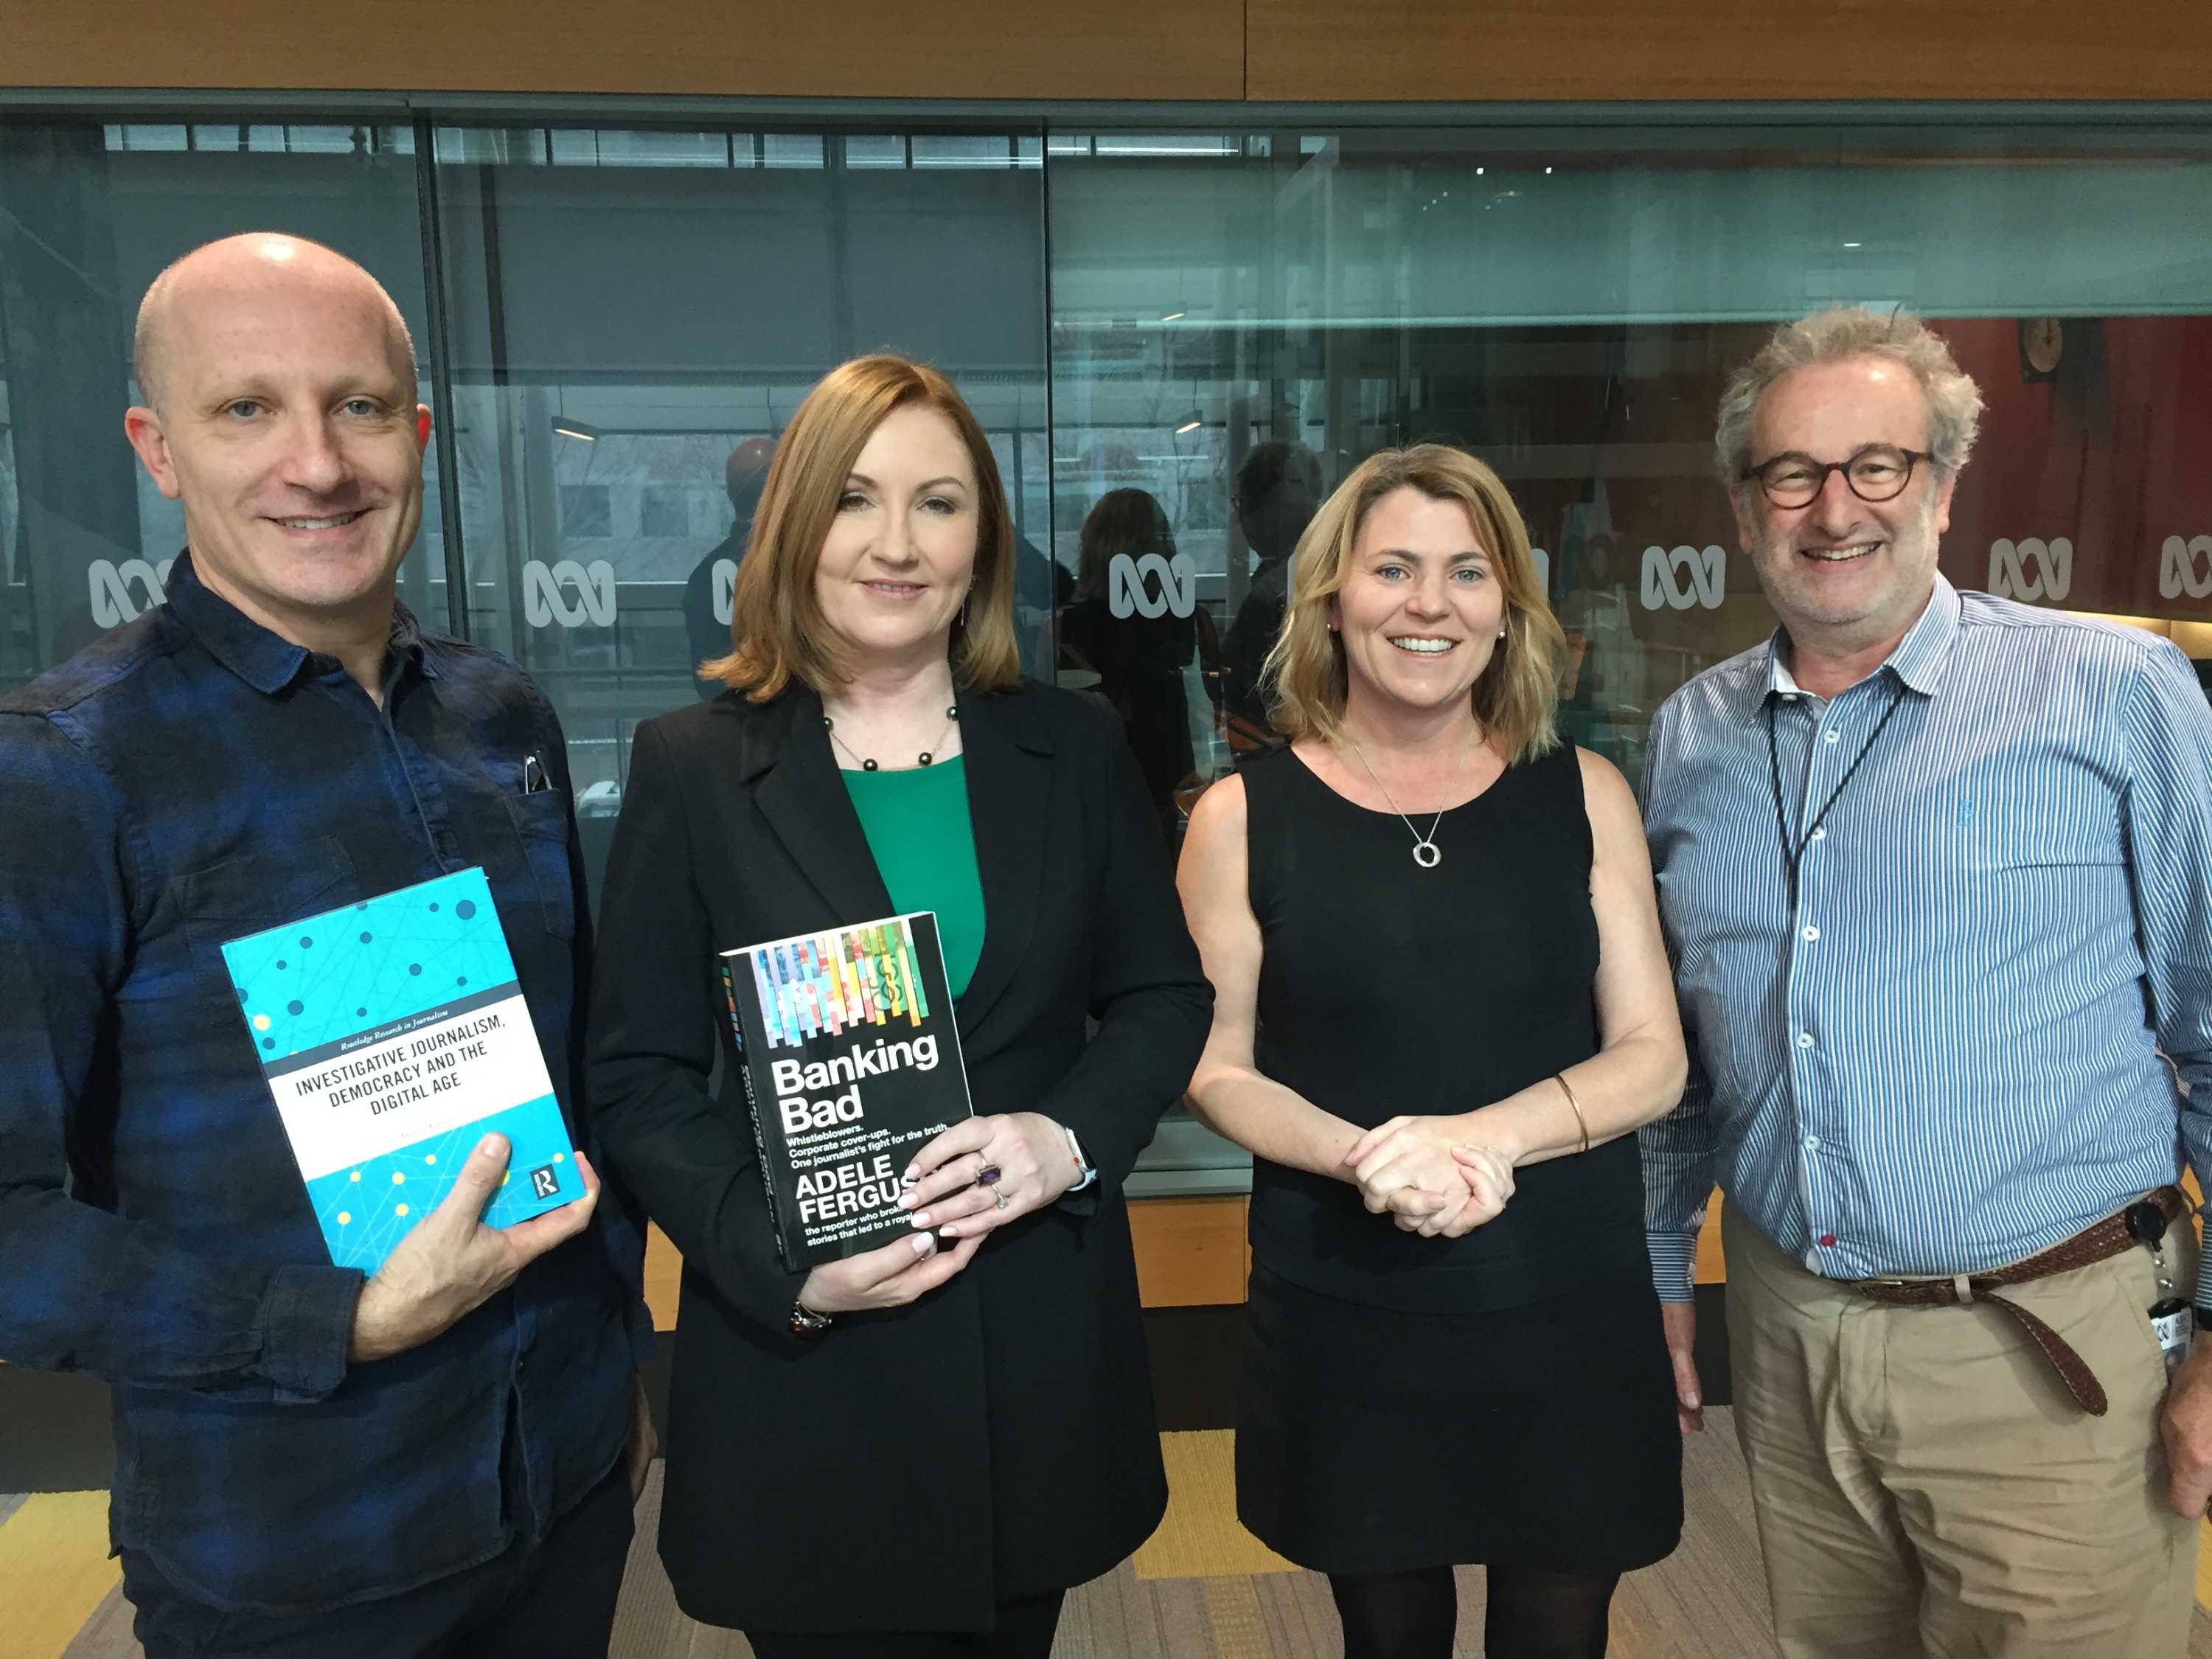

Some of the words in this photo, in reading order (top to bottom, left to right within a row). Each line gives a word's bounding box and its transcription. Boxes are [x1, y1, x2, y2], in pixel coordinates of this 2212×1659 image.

[296, 1046, 406, 1096] INVESTIGATIVE
[329, 1063, 420, 1107] DEMOCRACY
[427, 1052, 455, 1074] AND
[458, 1040, 487, 1061] THE
[771, 1034, 939, 1096] Banking
[370, 1085, 428, 1115] DIGITAL
[433, 1072, 460, 1093] AGE
[779, 1084, 863, 1134] Bad
[785, 1124, 863, 1147] Whistleblowers.
[788, 1141, 838, 1161] Corporate
[840, 1128, 891, 1147] cover-ups.
[790, 1158, 812, 1169] One
[867, 1138, 891, 1151] fight
[891, 1135, 905, 1144] for
[906, 1130, 922, 1140] the
[796, 1153, 894, 1199] ADELE
[804, 1227, 820, 1235] the
[821, 1217, 858, 1232] reporter
[858, 1212, 878, 1222] who
[879, 1205, 904, 1217] brok
[807, 1234, 838, 1246] stories
[838, 1228, 858, 1239] that
[858, 1222, 872, 1234] led
